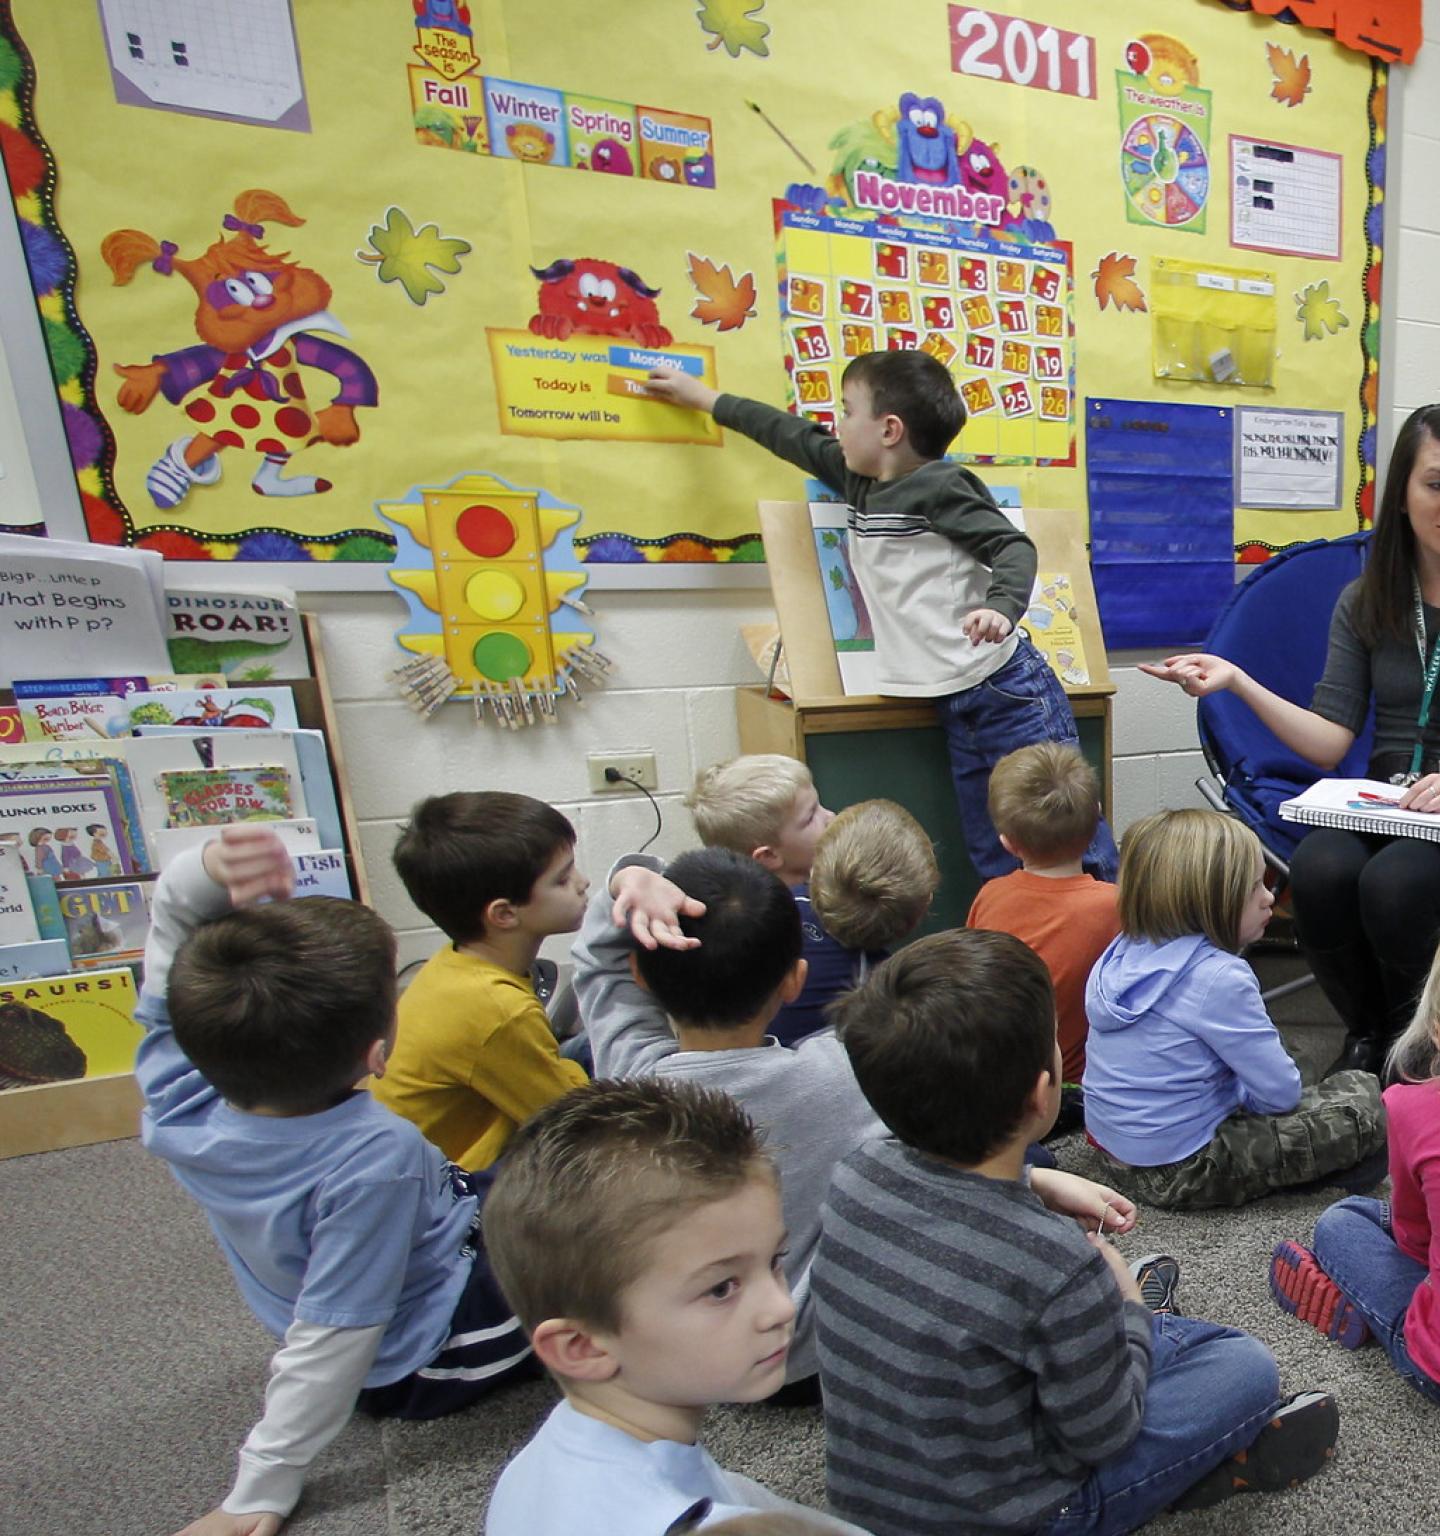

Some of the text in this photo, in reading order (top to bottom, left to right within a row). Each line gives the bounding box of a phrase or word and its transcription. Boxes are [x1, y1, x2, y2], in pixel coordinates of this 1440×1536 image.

[433, 32, 457, 48] The
[424, 44, 471, 63] season
[957, 10, 1091, 97] 2011
[443, 58, 455, 73] is
[423, 80, 469, 108] Fall
[1125, 87, 1146, 104] The
[1149, 96, 1193, 112] weather
[490, 91, 560, 123] Winter
[570, 106, 633, 142] Spring
[642, 117, 710, 148] Summer
[855, 170, 1004, 225] November
[897, 256, 1057, 299] 1 2 3 4 5
[808, 293, 1063, 335] 6 7 8 9 10 11 12
[505, 343, 576, 364] Yesterday
[580, 351, 609, 363] was
[805, 336, 828, 358] 13
[852, 334, 873, 356] 14
[975, 344, 993, 365] 17
[1008, 351, 1028, 372] 18
[1043, 355, 1061, 376] 19
[534, 377, 577, 393] Today
[803, 381, 1065, 416] 20 24 25 26
[508, 405, 620, 423] Tomorrow will be
[52, 592, 126, 610] Begins
[168, 596, 288, 611] DINOSAUR
[14, 616, 63, 630] with
[67, 616, 79, 630] P
[172, 613, 290, 633] ROAR!
[125, 680, 137, 693] 3
[40, 718, 84, 736] Number
[184, 783, 255, 805] GLASSES
[0, 803, 97, 818] LUNCH BOXES
[197, 797, 230, 814] FOR
[297, 855, 341, 871] Fish
[296, 874, 320, 887] ark
[0, 904, 24, 913] orld
[59, 889, 134, 918] GET
[0, 976, 129, 1002] SAURS!
